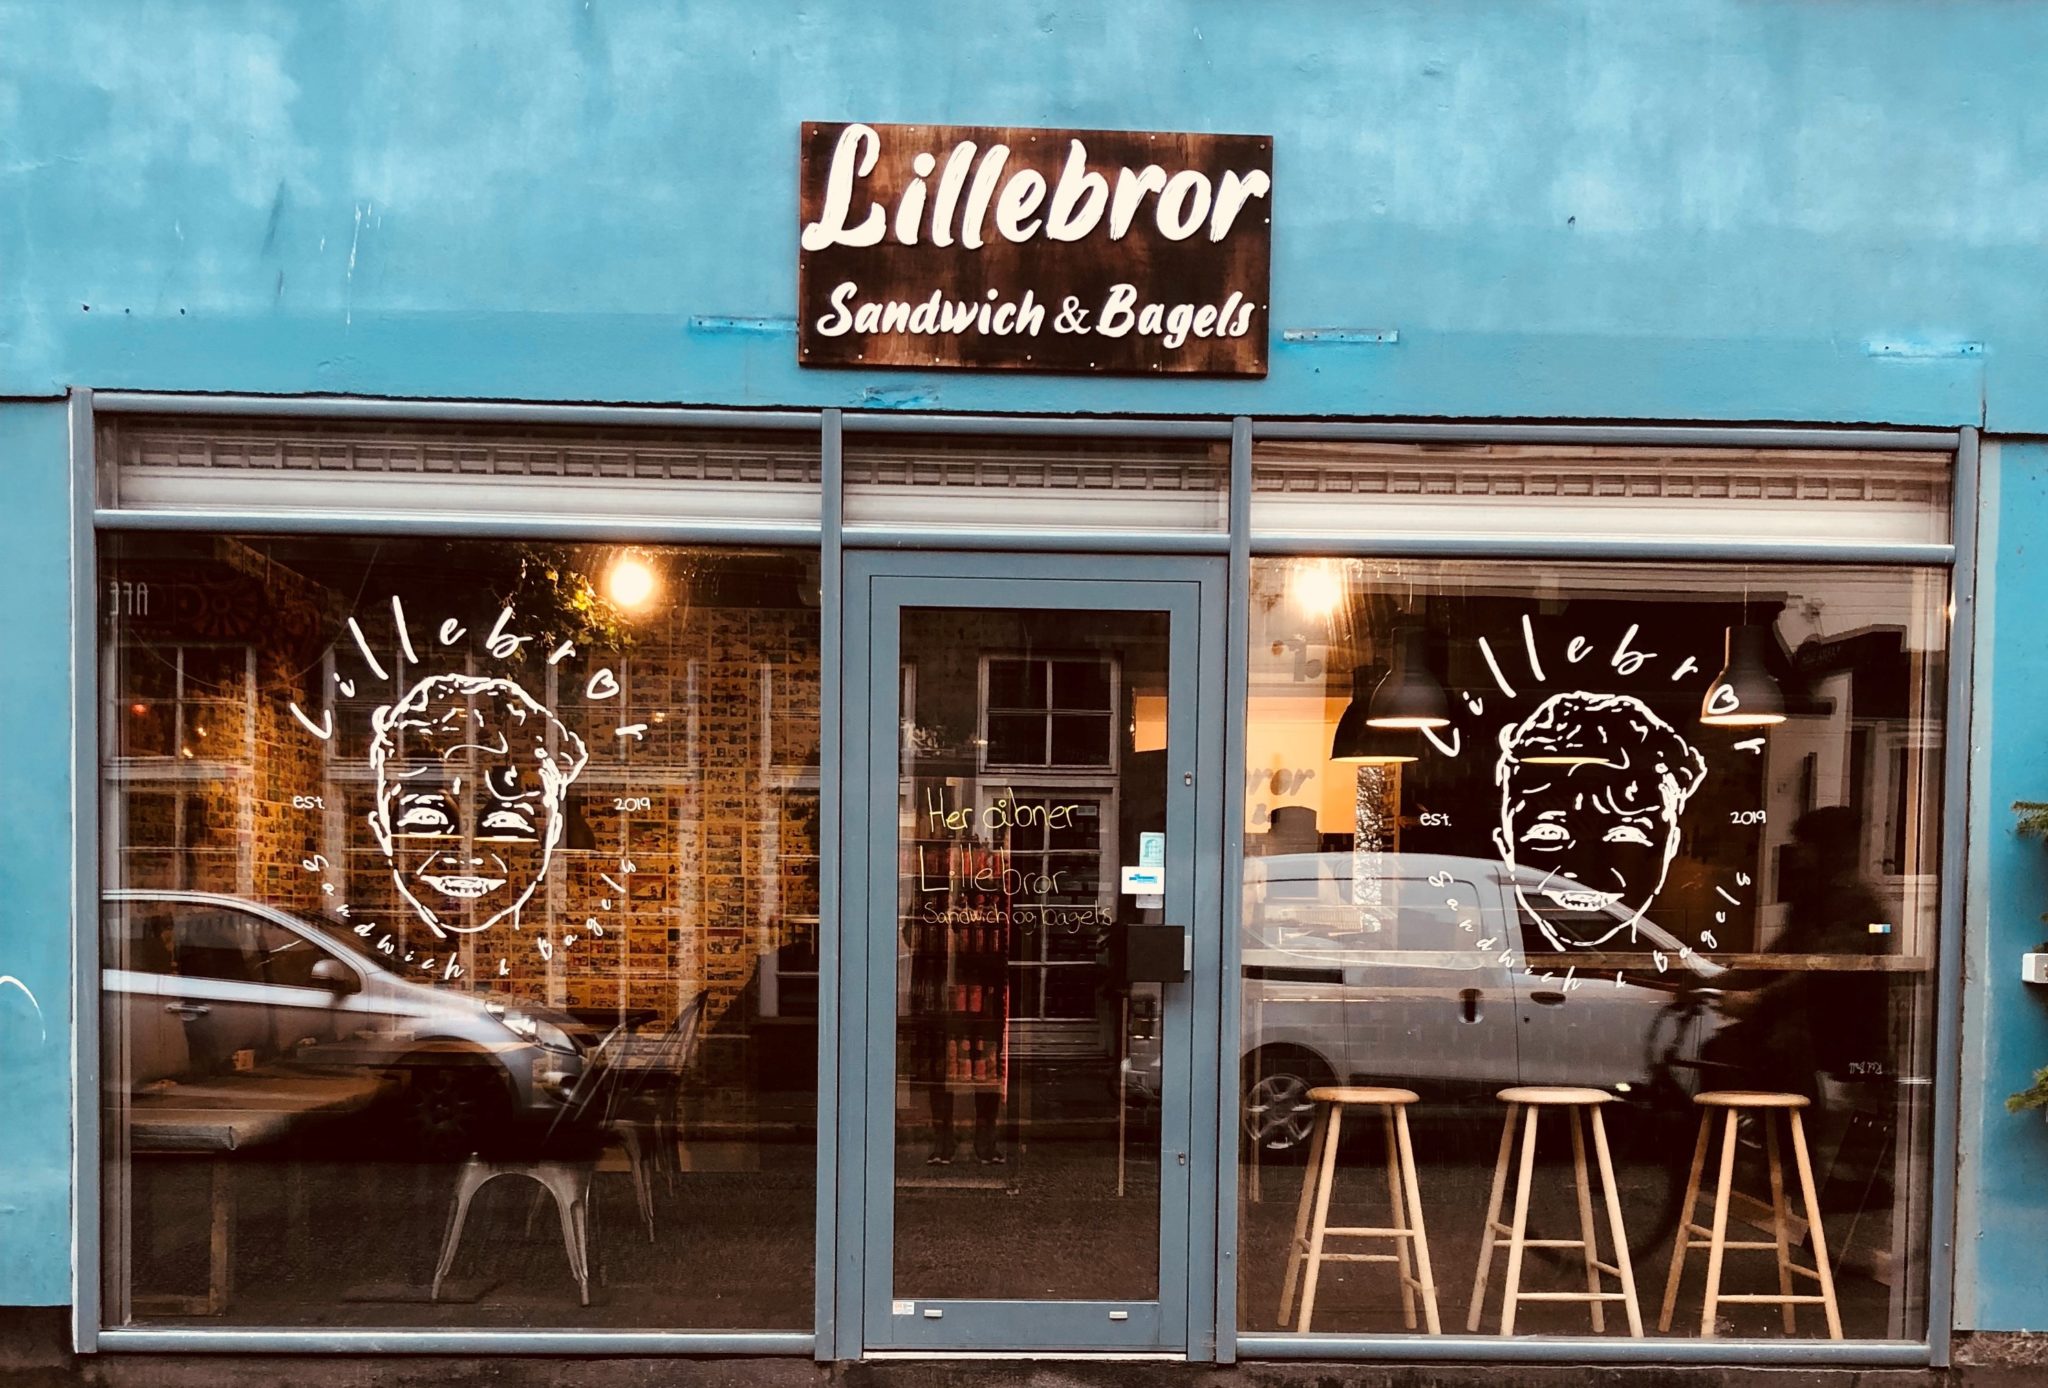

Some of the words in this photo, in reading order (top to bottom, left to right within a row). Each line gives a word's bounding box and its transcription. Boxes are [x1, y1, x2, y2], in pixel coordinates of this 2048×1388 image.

[801, 123, 1271, 251] Lillebror
[816, 281, 1045, 336] Sandwich
[1053, 295, 1090, 334] &
[1096, 283, 1255, 348] Bagels
[613, 797, 651, 812] 2019
[927, 787, 973, 832] Her
[1730, 810, 1767, 825] 2019
[920, 842, 1068, 896] Lillebror
[922, 901, 1010, 924] Sandwich
